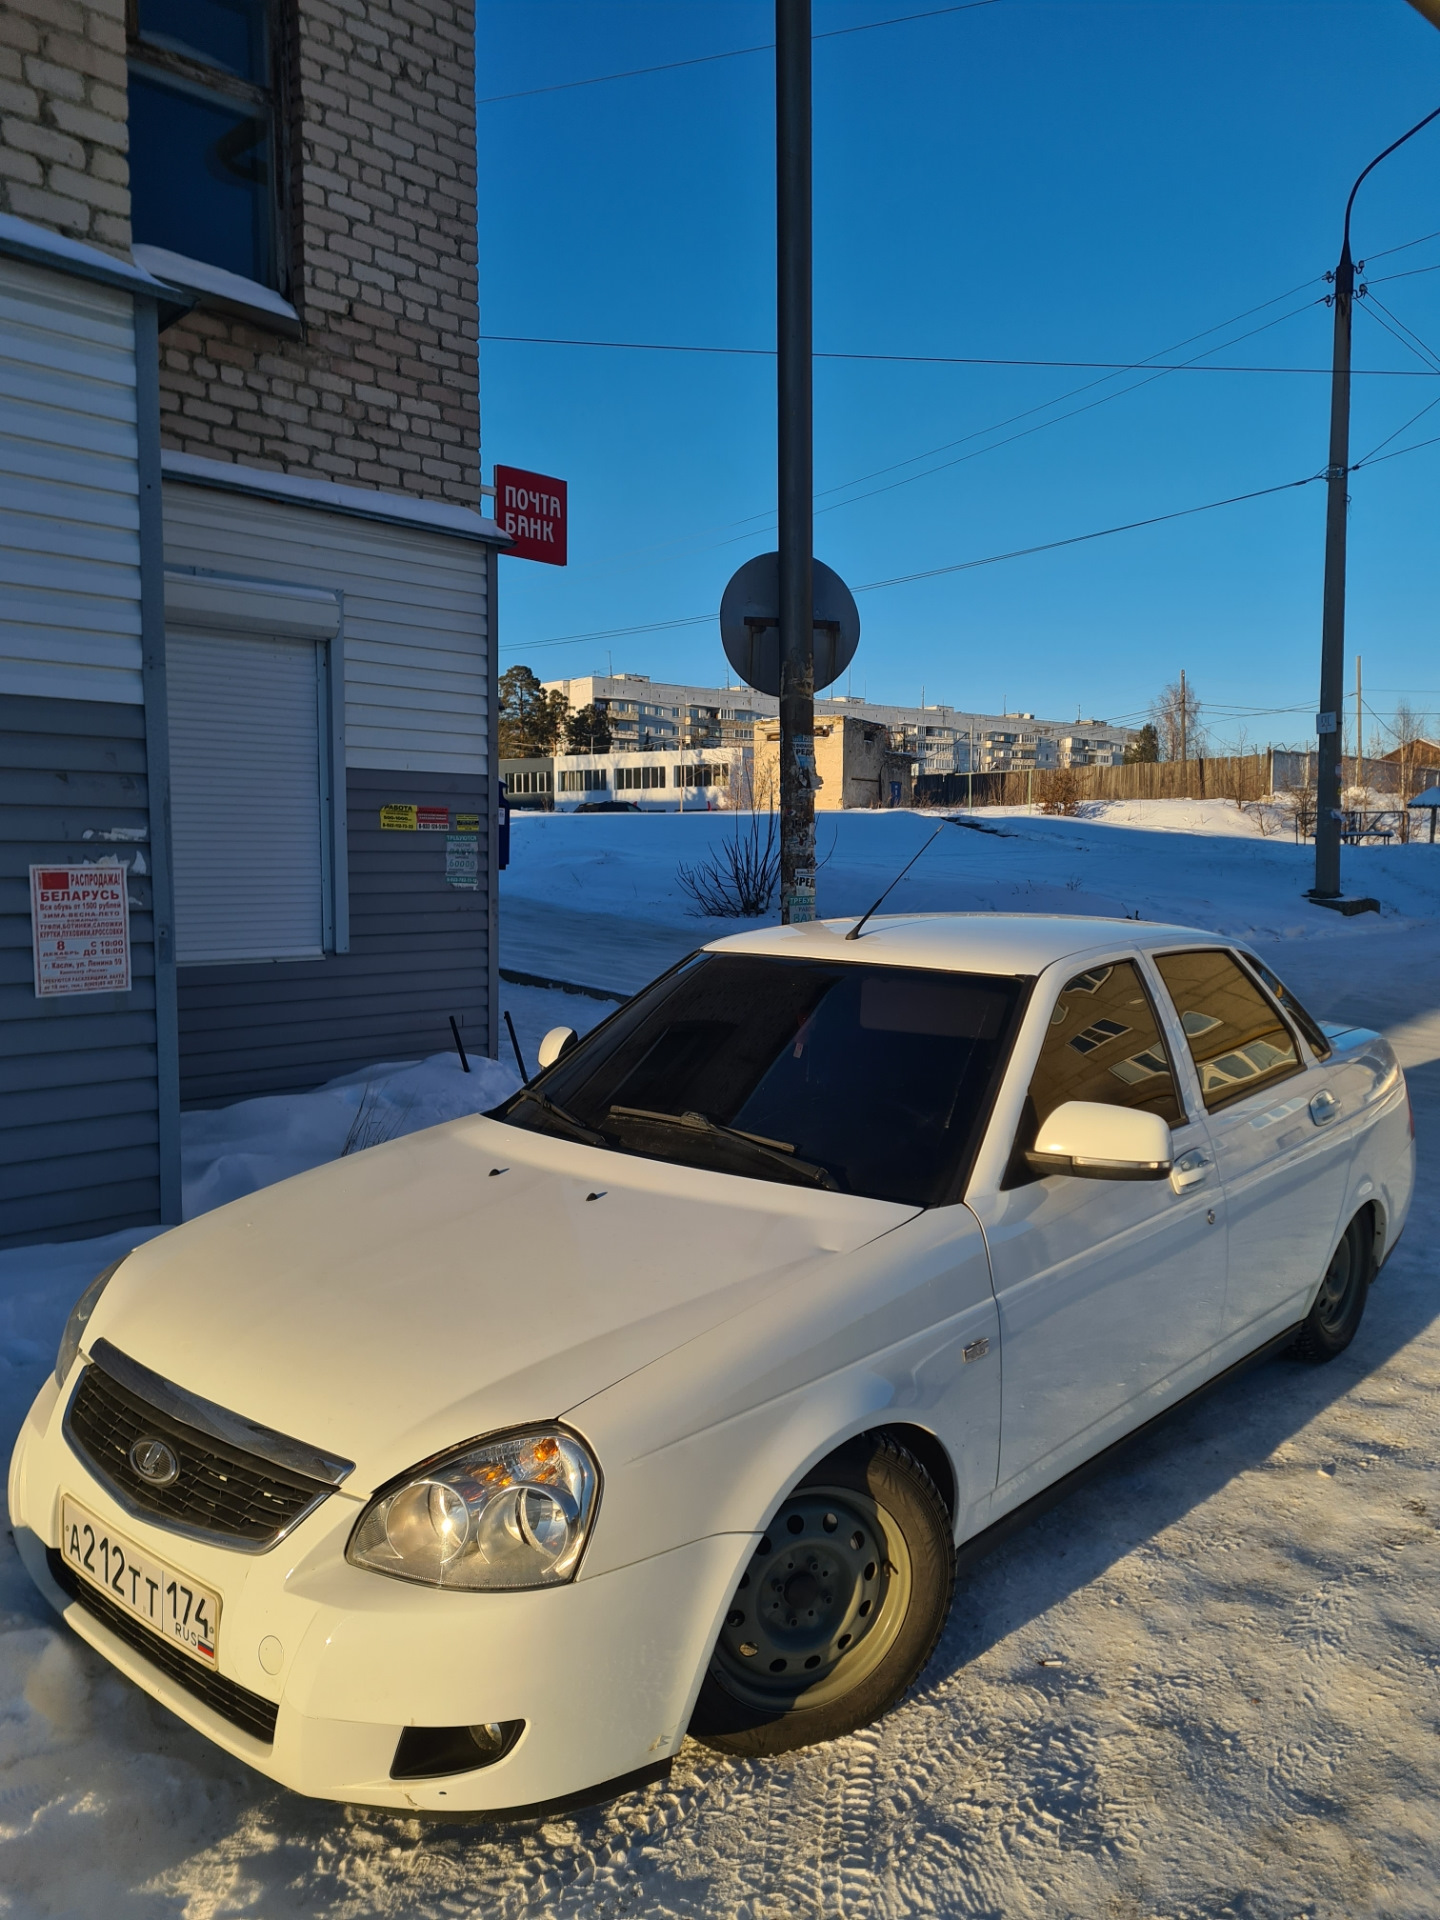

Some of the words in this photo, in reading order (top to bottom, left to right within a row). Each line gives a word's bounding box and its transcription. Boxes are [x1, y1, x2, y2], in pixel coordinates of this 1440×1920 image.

[505, 485, 562, 519] ПОЧТА
[505, 511, 555, 544] БАНК
[71, 873, 121, 887] РАСПРОДАЖА!
[40, 889, 120, 902] БЕЛАРУСЬ
[40, 903, 52, 911] Вся
[54, 903, 73, 911] обувь
[98, 901, 121, 910] рублей
[56, 940, 66, 951] 8
[100, 939, 124, 948] 10:00
[83, 948, 97, 957] ДО
[100, 947, 124, 955] 18:00
[87, 959, 113, 967] Ленина
[166, 1581, 209, 1640] 174
[174, 1621, 198, 1648] RUS
